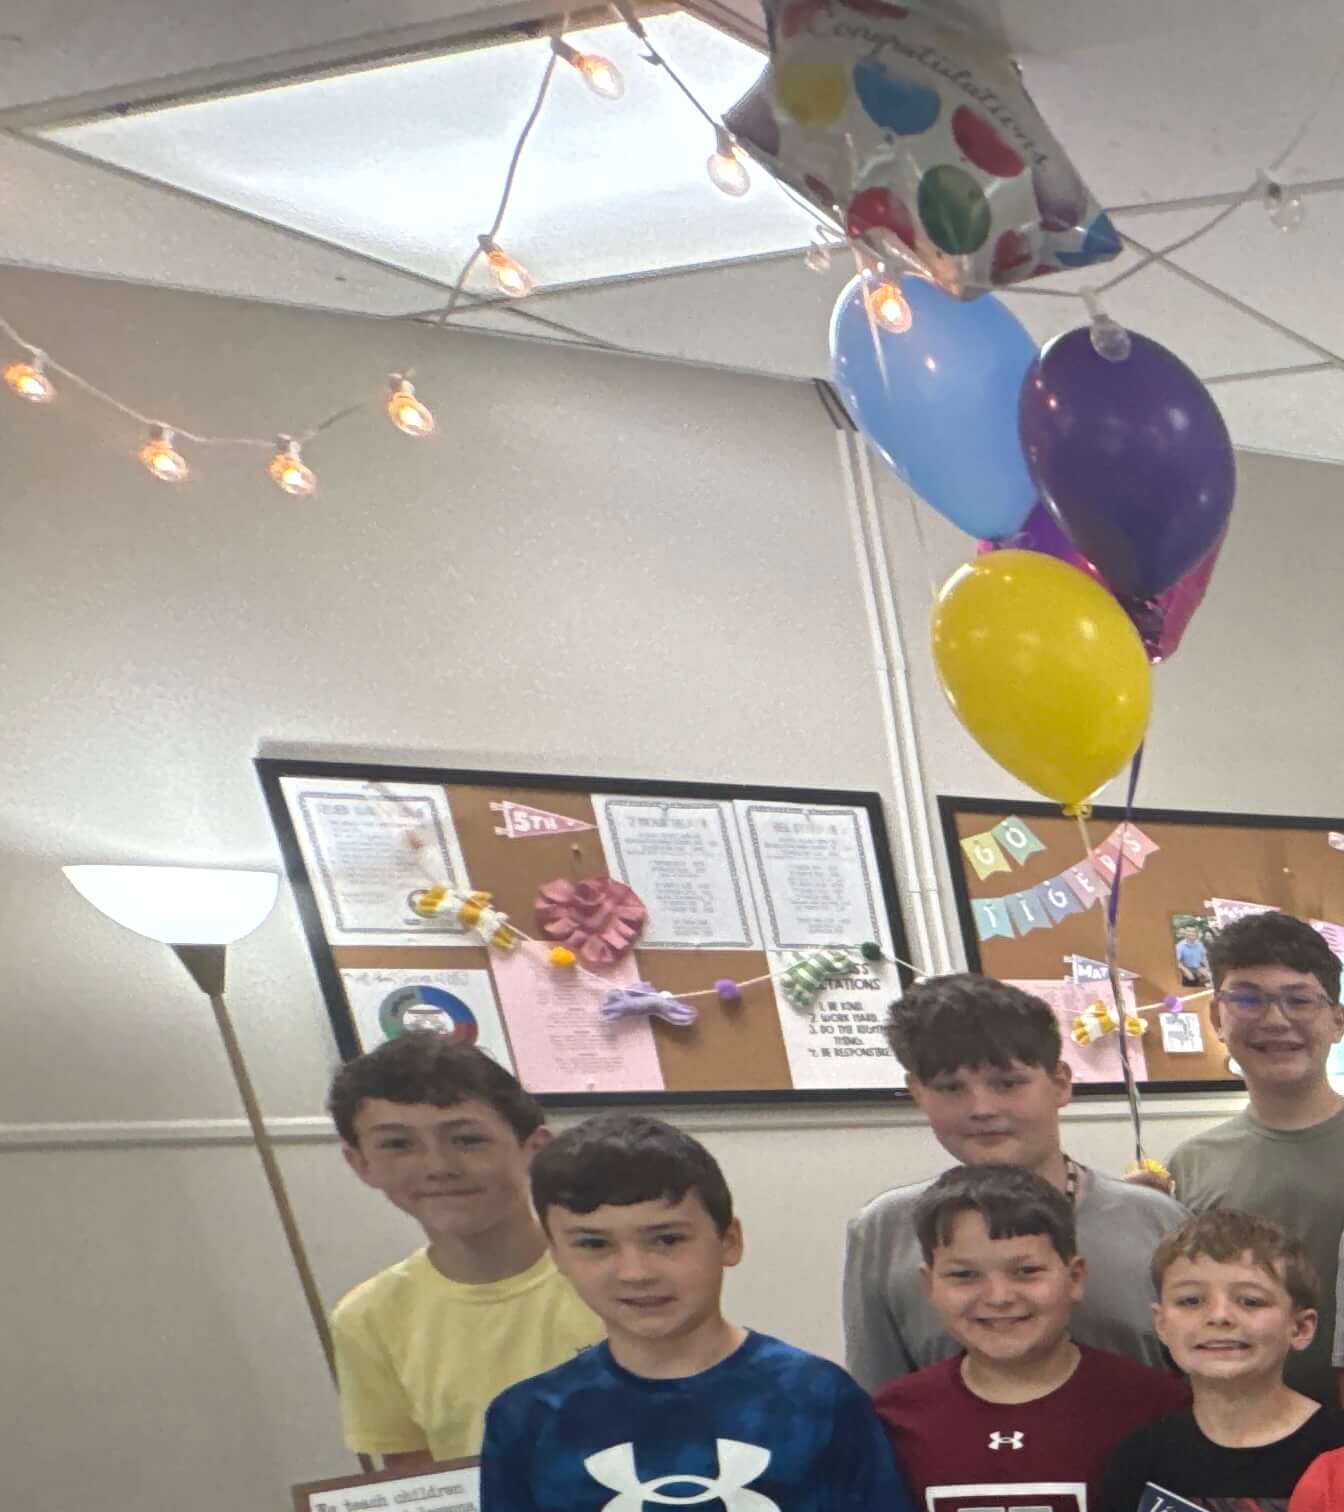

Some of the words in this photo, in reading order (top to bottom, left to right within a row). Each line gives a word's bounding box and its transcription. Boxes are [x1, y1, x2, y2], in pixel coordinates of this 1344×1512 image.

[974, 827, 1027, 865] GO
[983, 831, 1142, 929] TIGERS
[1078, 964, 1109, 981] MAT
[393, 1485, 465, 1503] children
